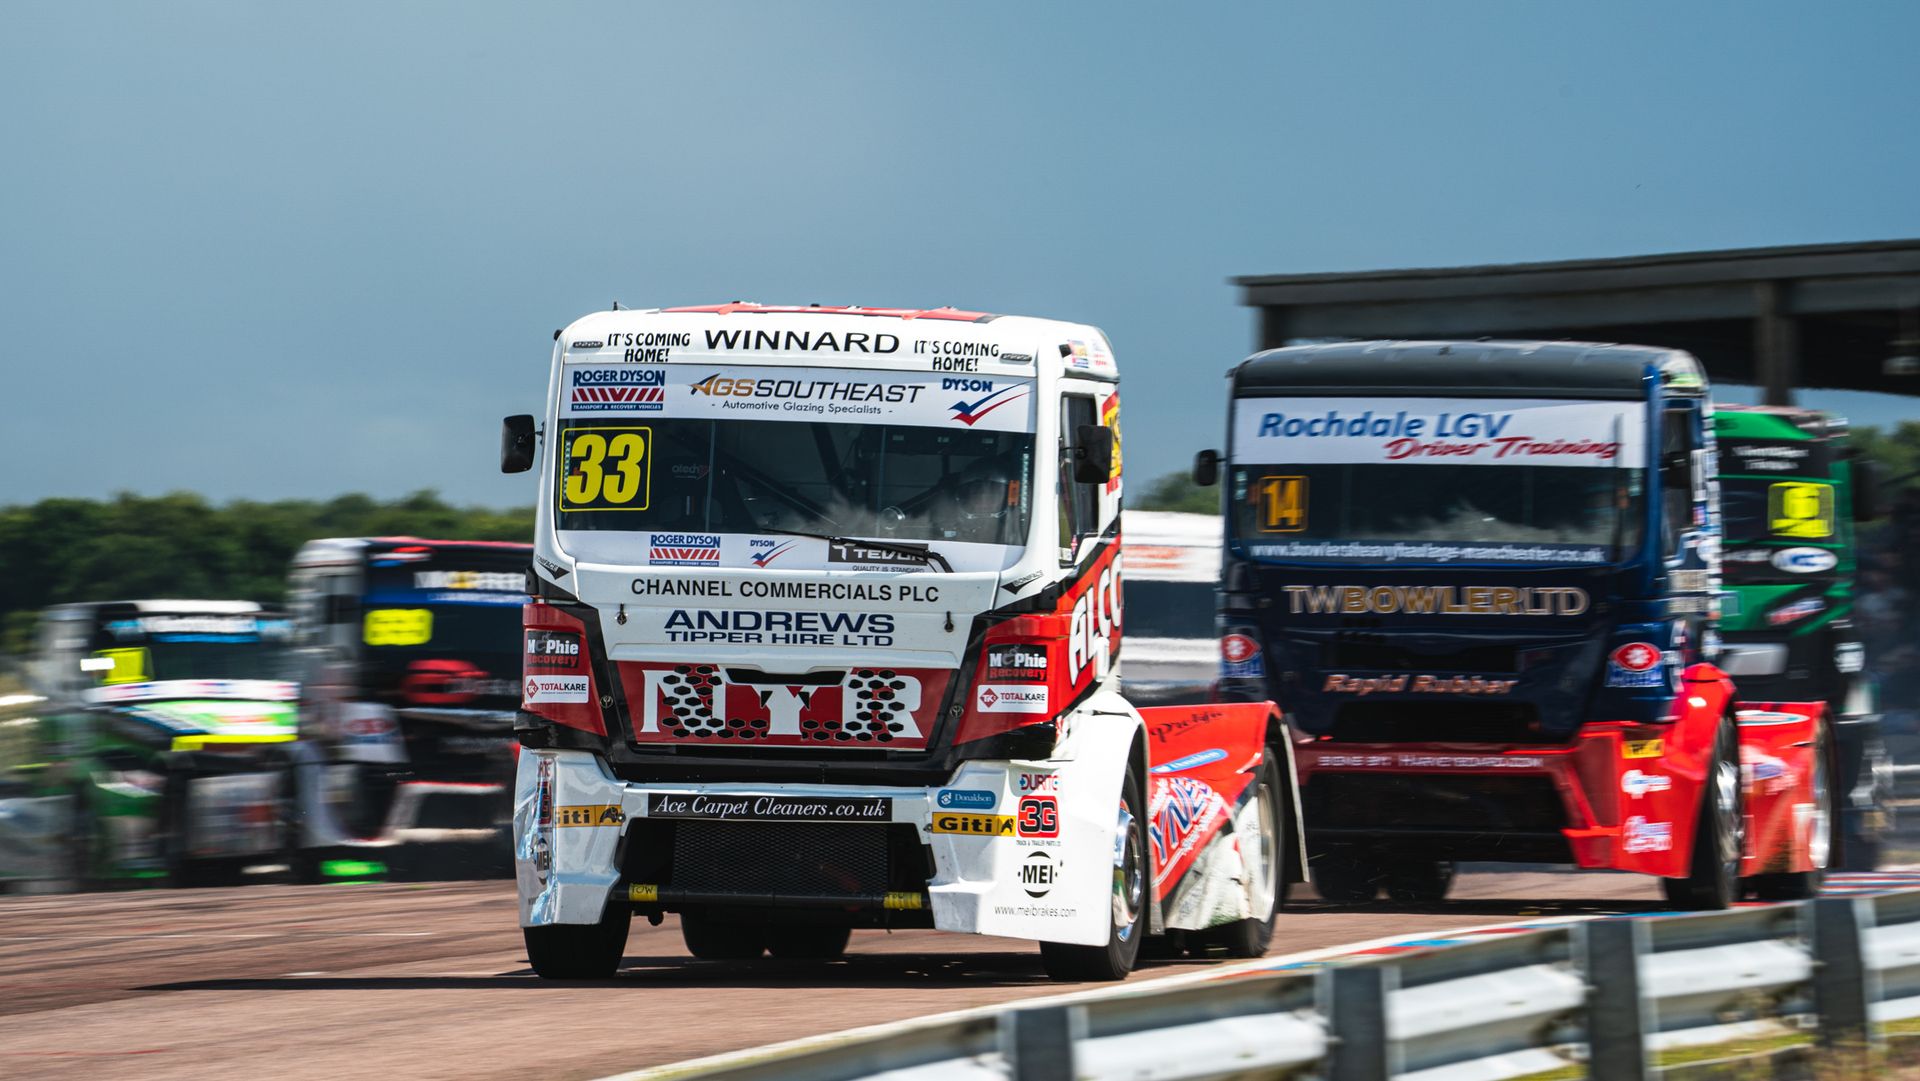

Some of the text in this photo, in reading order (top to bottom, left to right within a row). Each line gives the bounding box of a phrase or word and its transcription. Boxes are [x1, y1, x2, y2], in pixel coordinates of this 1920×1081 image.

[607, 333, 690, 347] IT'S COMING
[705, 329, 900, 354] WINNARD
[914, 339, 999, 357] IT'S COMING
[624, 348, 670, 363] HOME!
[932, 357, 978, 372] HOME!
[573, 370, 666, 386] ROGER DYSON
[942, 377, 993, 393] DYSON
[722, 400, 882, 415] Automotive Glazing Specialists
[1258, 410, 1514, 438] Rochdale LGV
[1491, 436, 1624, 460] Training
[565, 433, 645, 504] 33
[1263, 479, 1304, 526] 14
[651, 535, 721, 548] ROGER DYSON
[750, 539, 775, 548] DYSON
[631, 578, 939, 602] CHANNEL COMMERCIALS PLC
[664, 609, 895, 633] ANDREWS
[665, 630, 893, 647] TIPPER HIRE LTD
[527, 655, 578, 667] Recovery
[989, 668, 1046, 681] Recovery
[541, 682, 587, 691] TOTALKARE
[1000, 692, 1046, 701] TOTALKARE
[954, 793, 992, 802] Donaldson
[655, 796, 885, 819] Ace Carpet Cleaners.co.uk
[556, 810, 590, 824] iti
[1020, 799, 1057, 833] 3G
[938, 816, 993, 833] Giti
[1022, 865, 1053, 884] MEI
